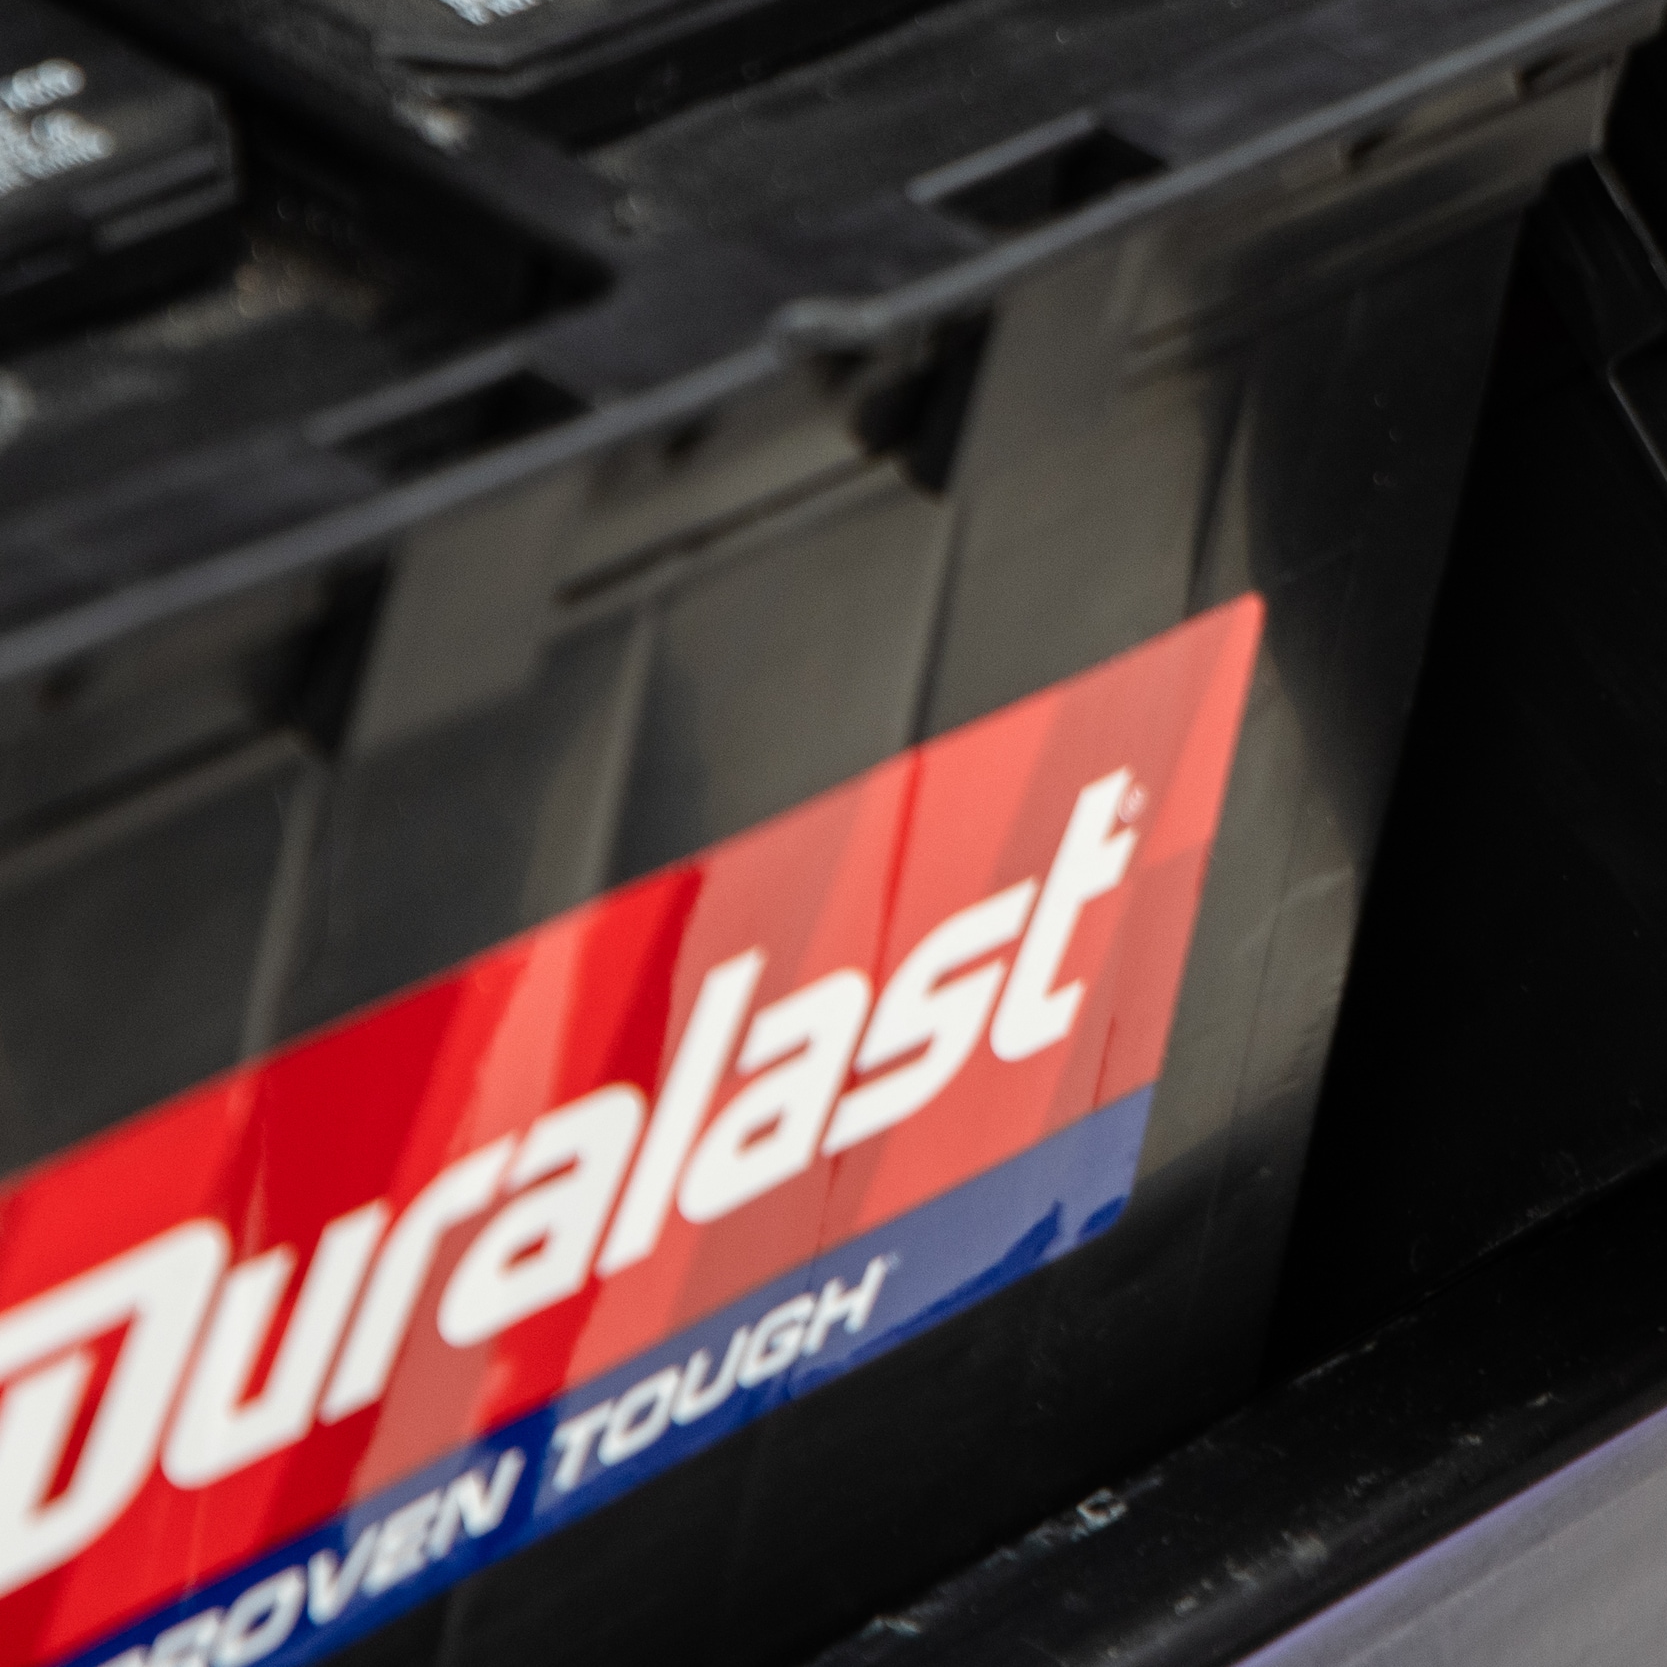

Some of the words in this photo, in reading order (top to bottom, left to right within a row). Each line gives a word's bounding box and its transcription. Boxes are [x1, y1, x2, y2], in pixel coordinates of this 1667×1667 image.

[0, 766, 1138, 1598] Duralast
[98, 1446, 526, 1667] ROVEN
[550, 1254, 888, 1494] TOUGH
